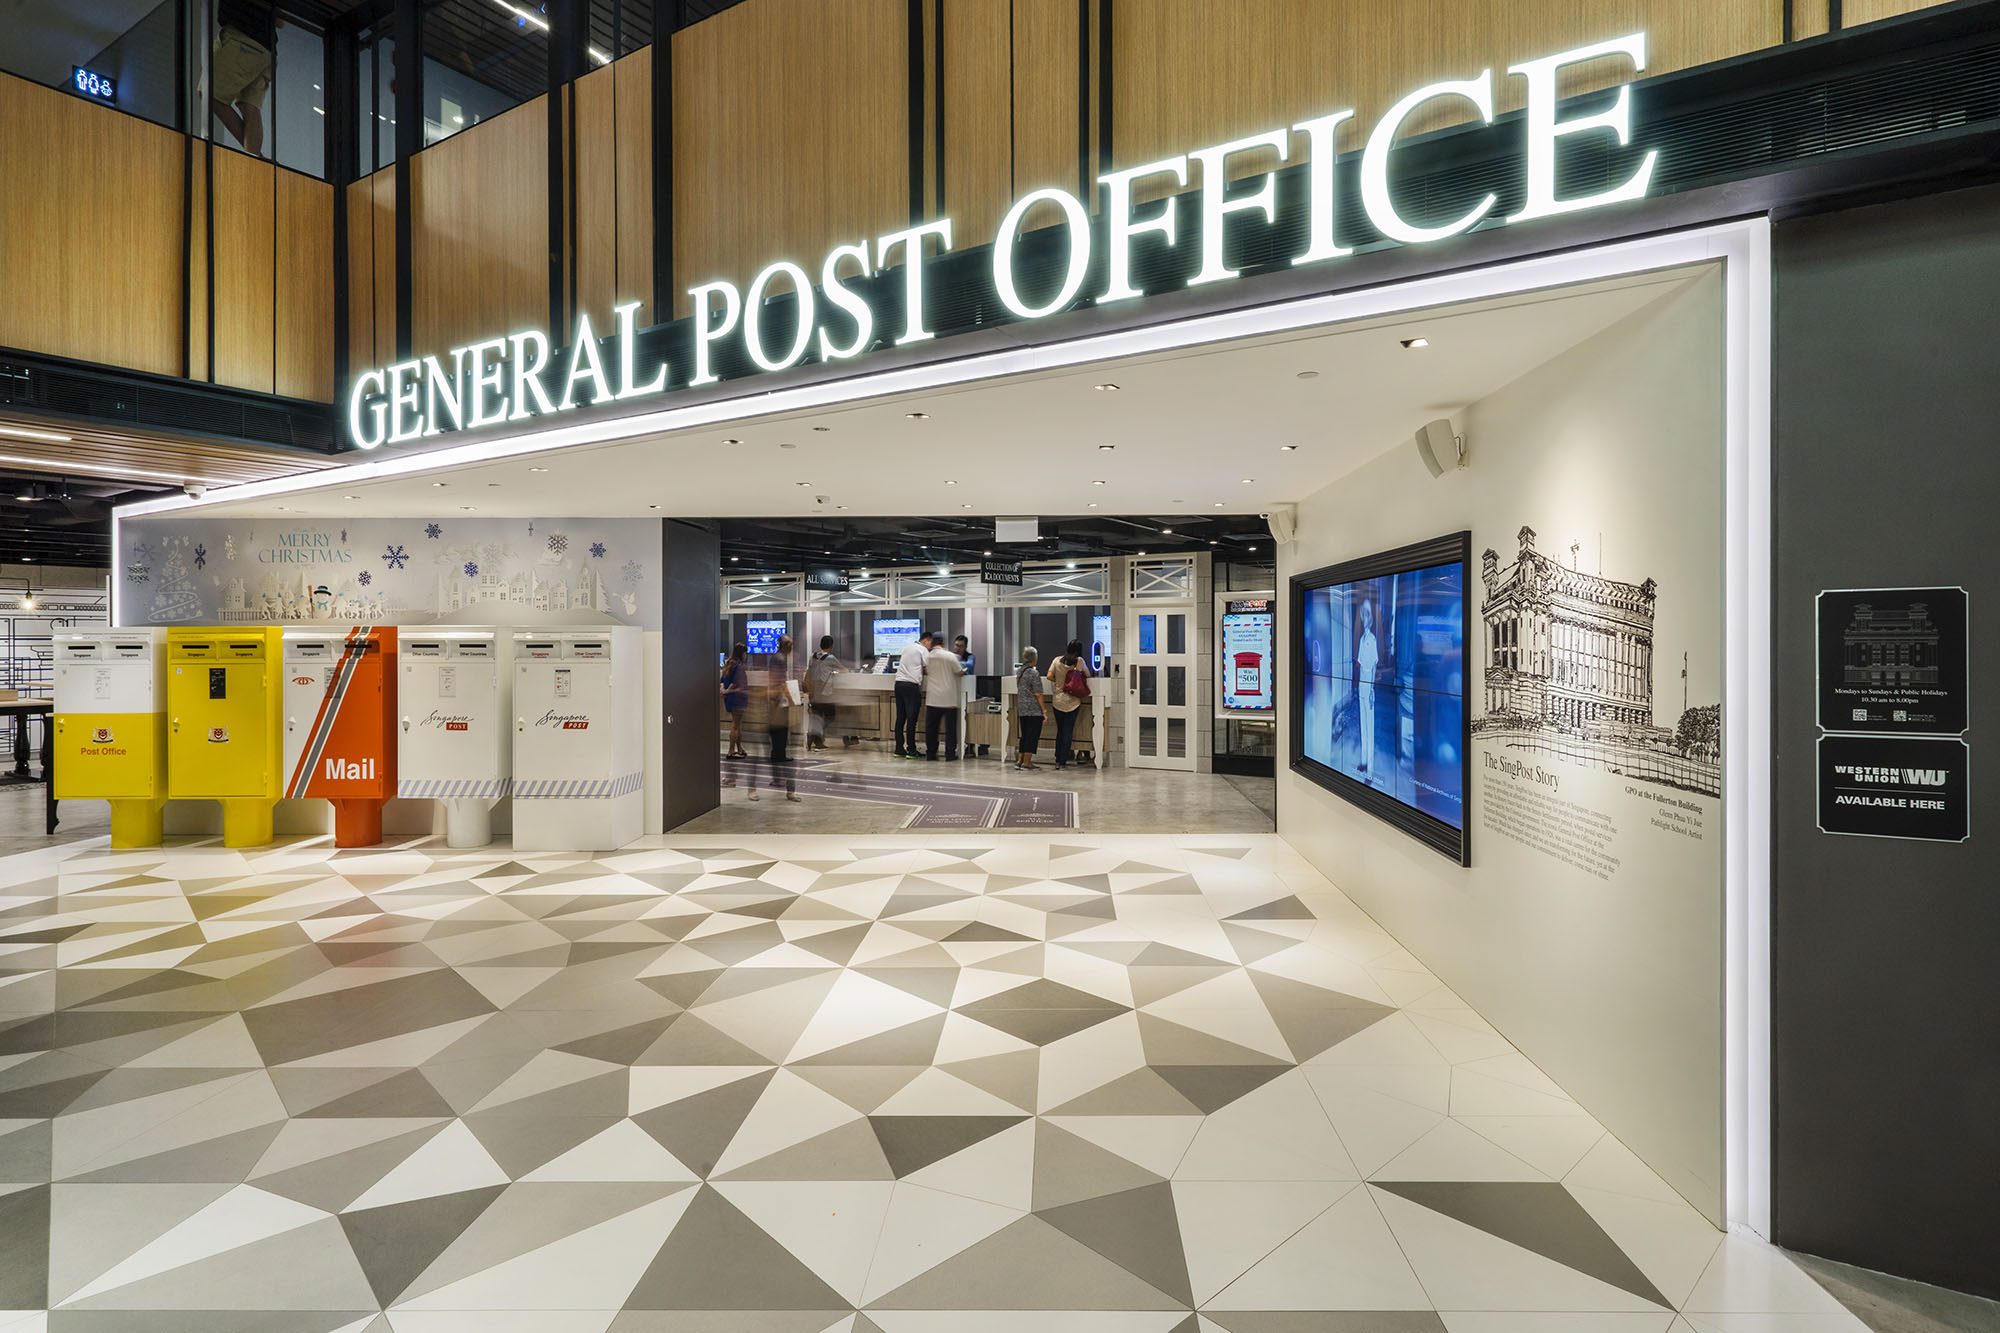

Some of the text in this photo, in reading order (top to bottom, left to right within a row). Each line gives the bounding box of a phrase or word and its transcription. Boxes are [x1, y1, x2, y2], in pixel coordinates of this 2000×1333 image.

[349, 31, 1658, 450] GENERAL POST OFFICE
[278, 533, 332, 547] MERRY
[258, 549, 352, 564] CHRISTMAS
[986, 562, 1019, 572] COLLECTION OF
[806, 574, 848, 586] ALL SERVICES
[992, 574, 1020, 582] DOCUMENTS
[420, 710, 474, 728] Singapore
[535, 709, 589, 728] Singapore
[80, 747, 126, 756] Post Office
[325, 758, 375, 780] Mail
[1484, 751, 1560, 792] The SingPost Story
[1834, 766, 1899, 776] WESTERN
[1854, 774, 1899, 784] UNION
[1625, 786, 1637, 796] GPO
[1678, 800, 1703, 815] Building
[1836, 795, 1945, 810] AVAILABLE HERE
